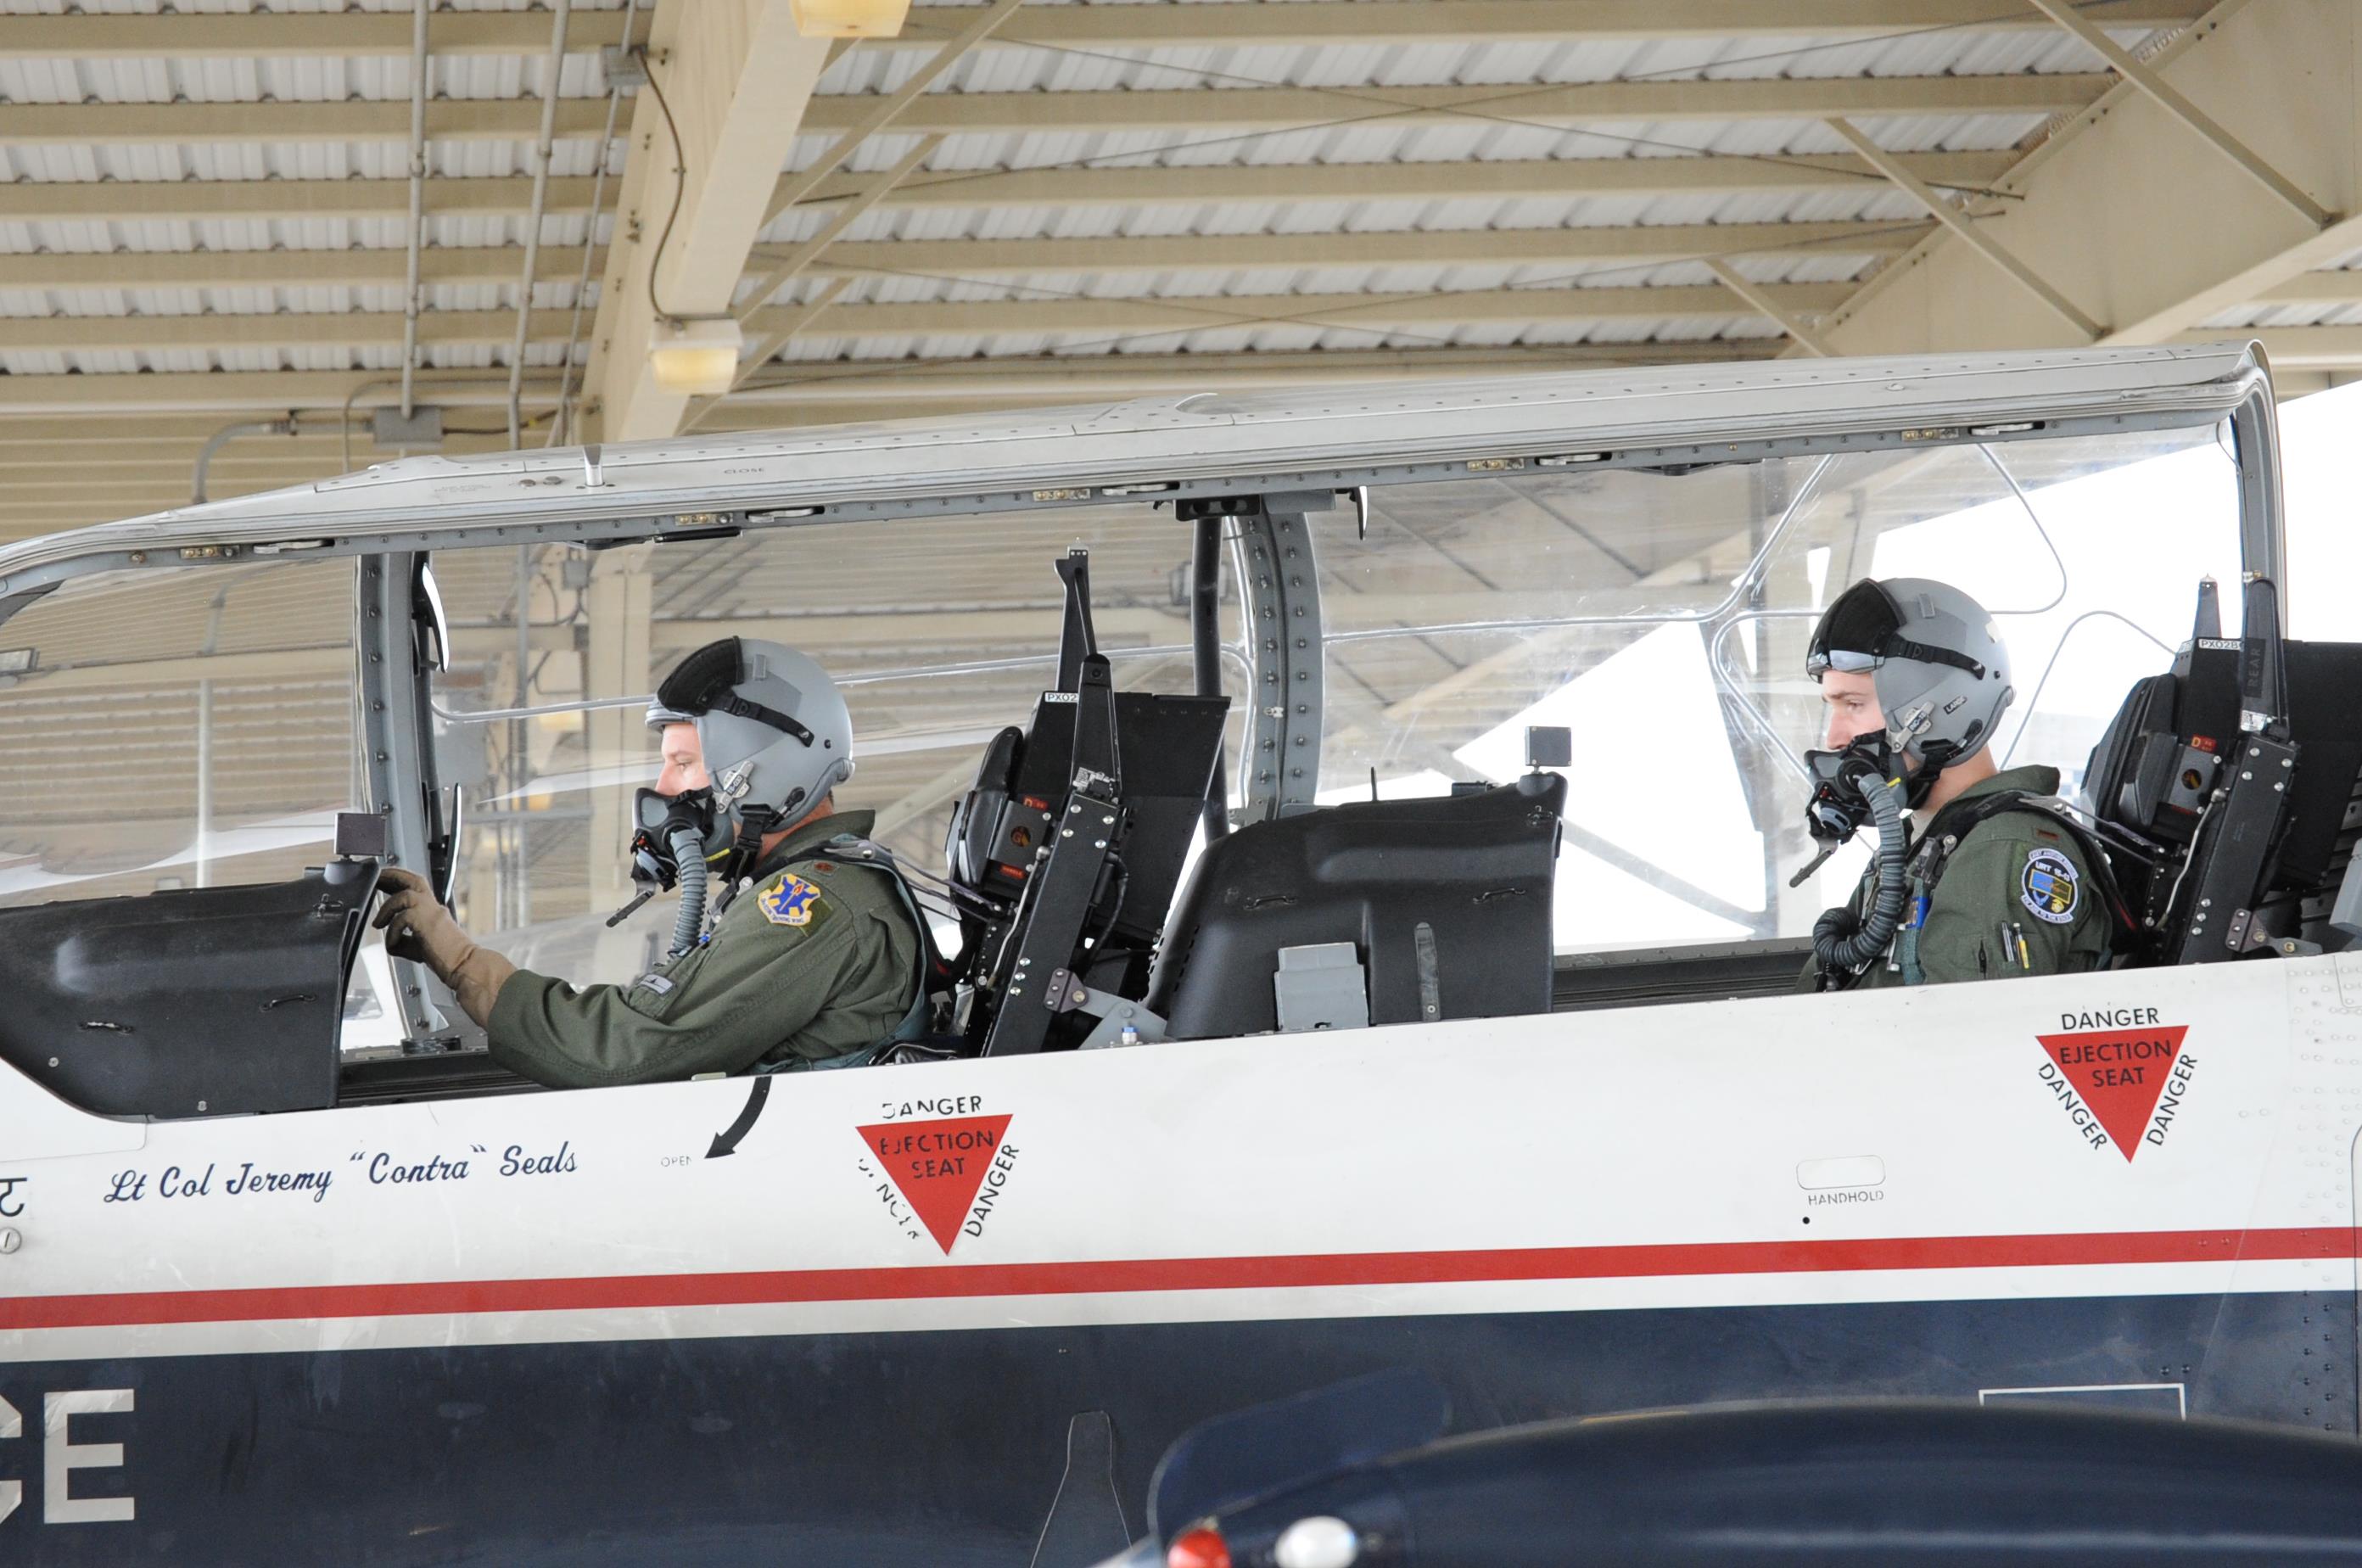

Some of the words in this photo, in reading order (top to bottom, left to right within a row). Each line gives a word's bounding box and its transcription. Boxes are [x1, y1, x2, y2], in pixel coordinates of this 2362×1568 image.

[2061, 1007, 2160, 1031] DANGER
[2059, 1039, 2173, 1065] EJECTION
[2092, 1067, 2146, 1089] SEAT
[2038, 1062, 2107, 1151] DANGER
[2146, 1054, 2198, 1146] DANGER
[880, 1130, 994, 1156] EJECTION
[103, 1169, 148, 1203] Lt
[160, 1163, 215, 1198] Col
[226, 1162, 333, 1203] Jeremy
[499, 1140, 578, 1177] Seals
[912, 1157, 965, 1179] SEAT
[964, 1145, 1020, 1237] DANGER
[1808, 1190, 1884, 1206] HANDHOLD
[0, 1388, 135, 1525] E
